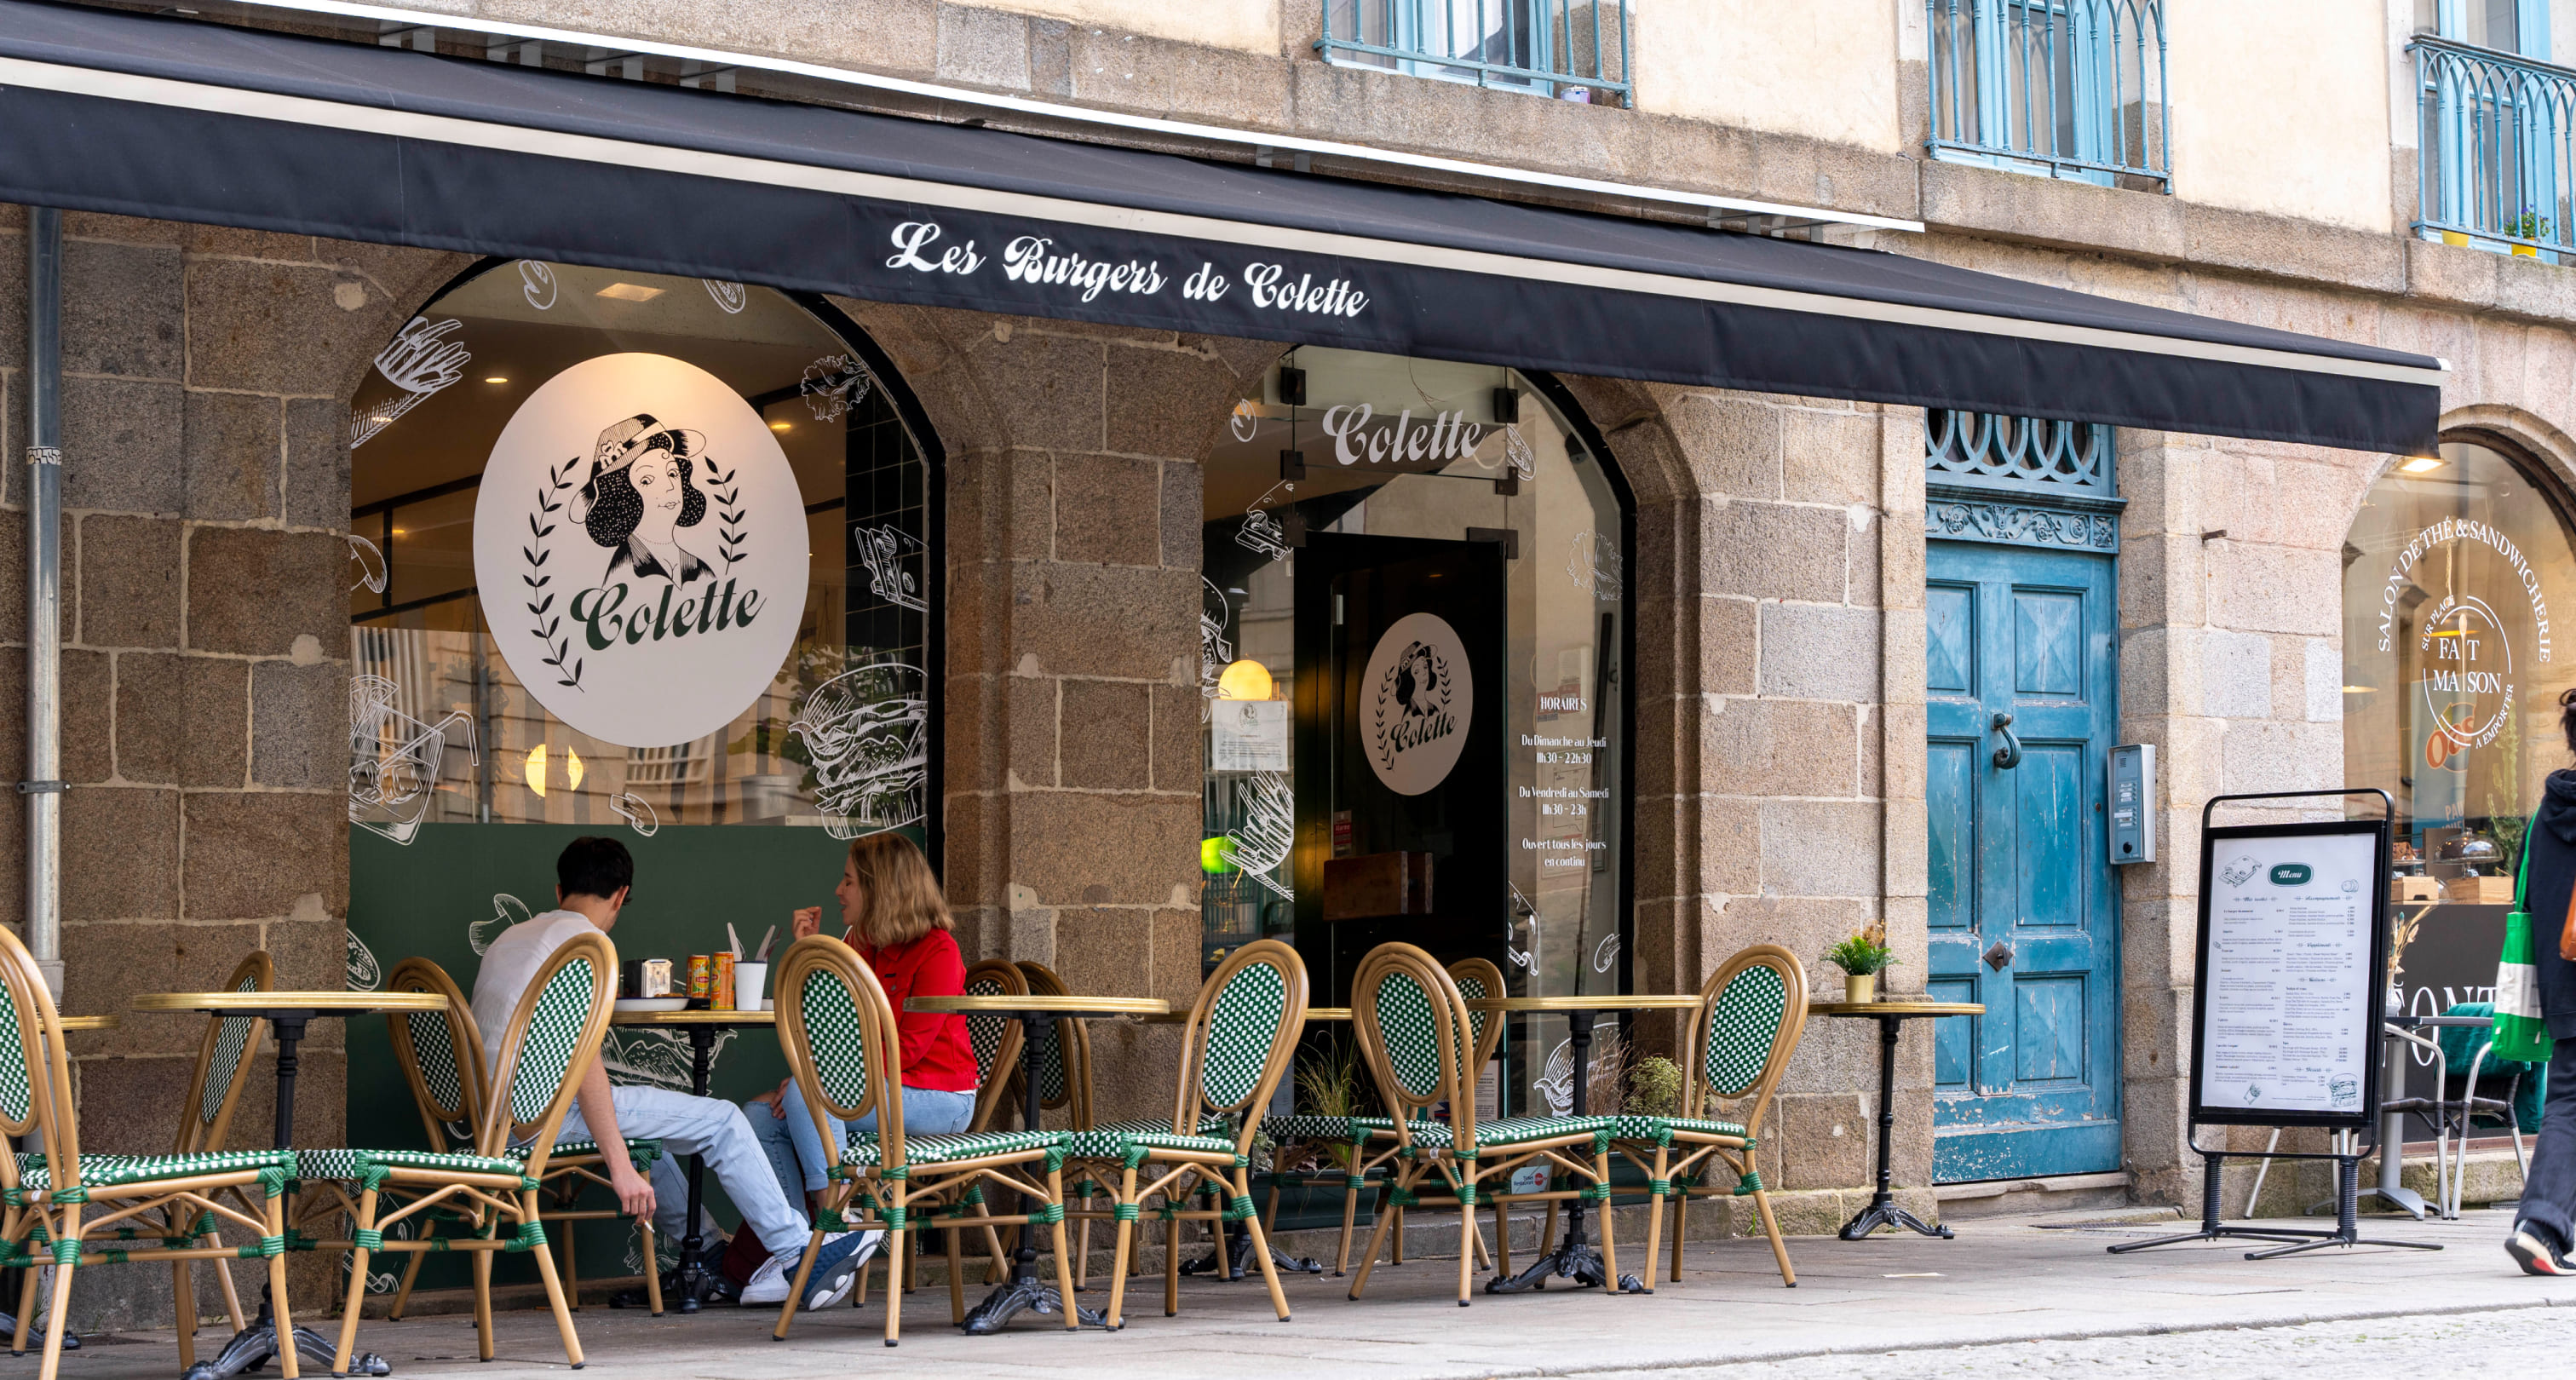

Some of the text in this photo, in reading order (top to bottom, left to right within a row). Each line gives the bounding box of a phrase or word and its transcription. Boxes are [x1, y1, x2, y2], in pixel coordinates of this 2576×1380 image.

[886, 222, 1370, 318] Les Burgers de Colette
[1322, 403, 1488, 465] Colette
[2378, 515, 2551, 663] SALON DE THÉ & SANDWICHERIE
[570, 578, 767, 651] Colette
[2422, 595, 2455, 651] SUR PLACE
[1540, 695, 1587, 711] HORAIRES
[2475, 684, 2514, 750] A EMPORTER
[1390, 711, 1458, 753] Colette
[1521, 733, 1607, 747] Du Dimanche au Jeudi
[1536, 752, 1557, 763] 11h30
[1564, 752, 1592, 763] 22h30
[1519, 785, 1609, 799] Du Vendredi au Samedi
[1542, 803, 1563, 815] 11h30
[1570, 803, 1587, 815] 23h
[1522, 837, 1607, 852] Ouvert tous les jours
[1544, 855, 1584, 866] en continu
[2278, 870, 2303, 878] Menu
